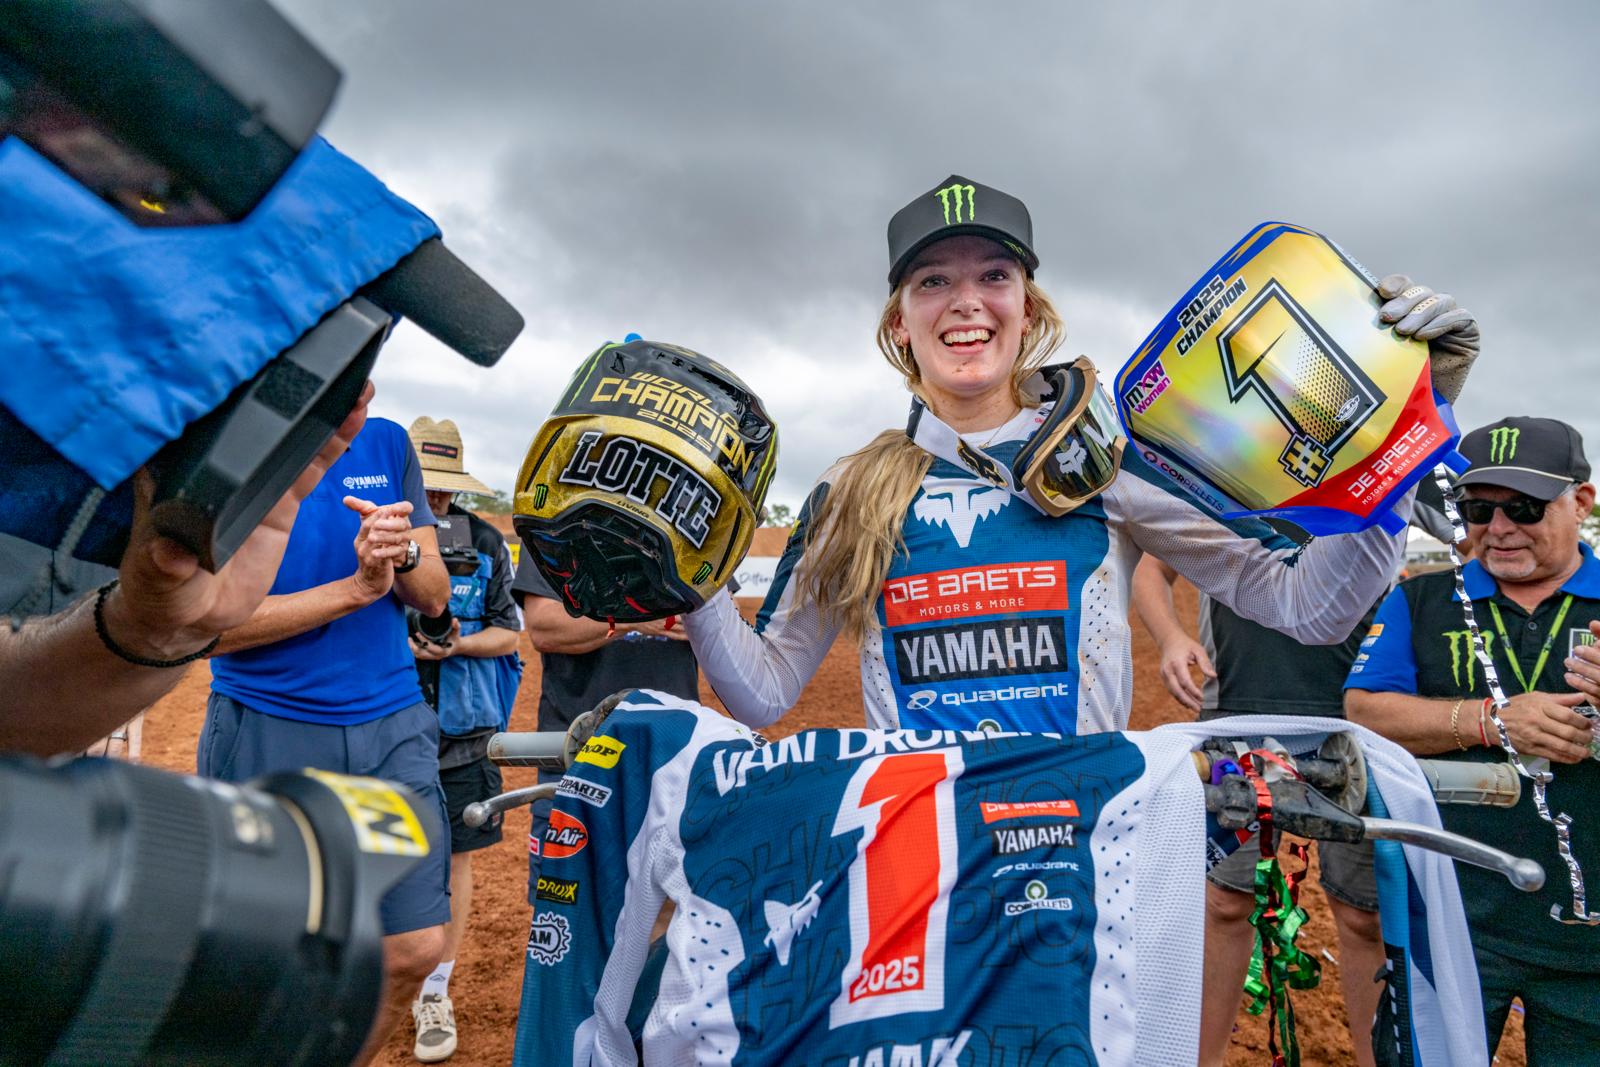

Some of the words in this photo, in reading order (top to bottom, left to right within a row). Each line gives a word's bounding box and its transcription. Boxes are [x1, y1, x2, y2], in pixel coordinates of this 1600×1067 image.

[1176, 277, 1247, 356] CHAMPION
[1178, 276, 1225, 329] 2025
[628, 371, 738, 428] WORLD
[590, 377, 755, 478] CHAMPION
[637, 409, 712, 452] 2025
[353, 474, 389, 486] YAMAHA
[1348, 471, 1376, 498] DE
[1371, 421, 1429, 476] BAETS
[1362, 481, 1388, 505] MOTORS
[1393, 457, 1412, 476] MORE
[1411, 432, 1438, 459] HASSELT
[558, 432, 722, 549] LOTTE
[1160, 462, 1225, 512] CORPELLETS
[617, 500, 650, 519] LIVING
[888, 578, 929, 605] DE
[937, 566, 1056, 597] BAETS
[919, 602, 970, 617] MOTORS
[975, 600, 983, 610] &
[989, 597, 1025, 609] MORE
[901, 624, 1059, 678] YAMAHA
[941, 682, 1069, 707] quadrant
[556, 828, 584, 847] Air
[995, 824, 1074, 854] YAMAHA
[1015, 861, 1080, 872] quadrant
[1007, 897, 1070, 914] CORPELLETS
[853, 955, 920, 999] 2025
